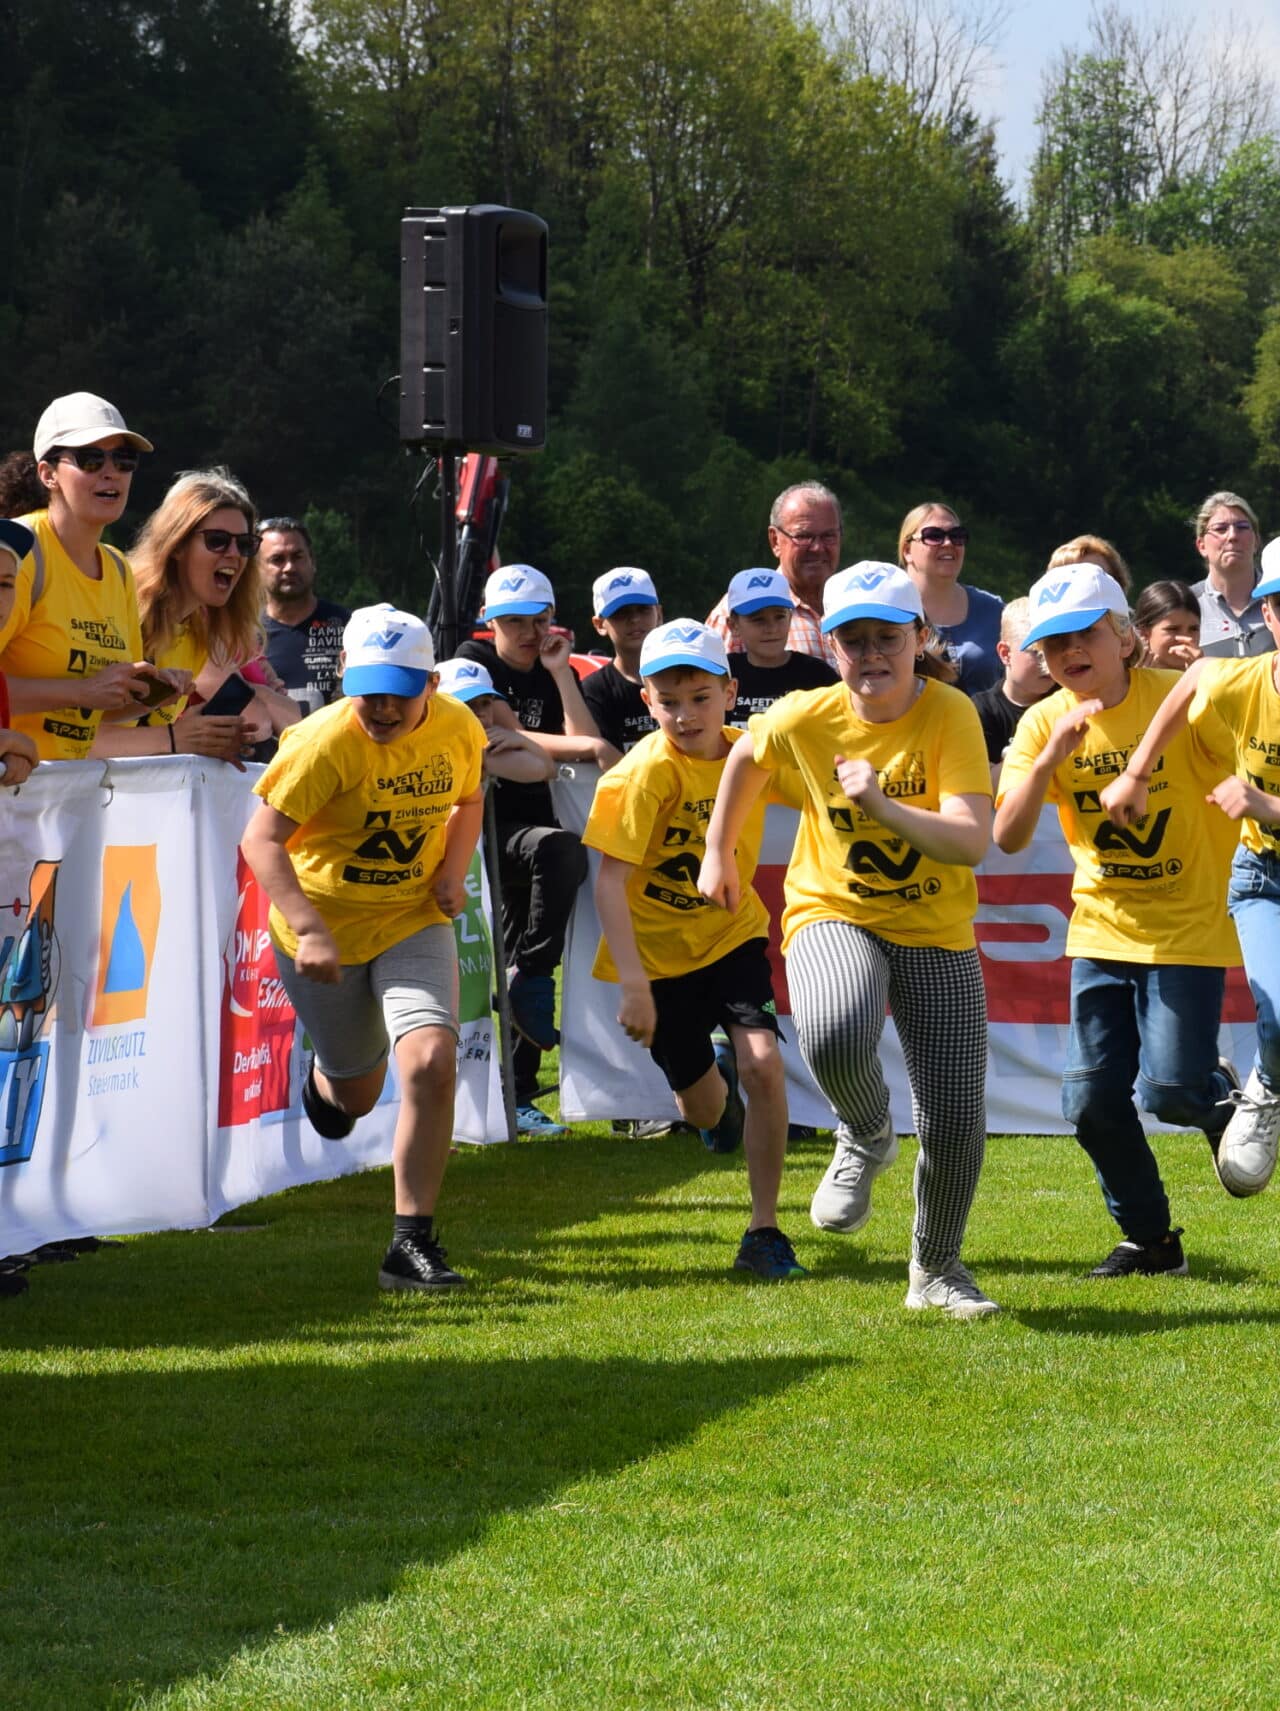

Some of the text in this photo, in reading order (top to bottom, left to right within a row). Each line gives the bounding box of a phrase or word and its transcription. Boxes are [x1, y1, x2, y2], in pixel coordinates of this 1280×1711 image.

[71, 618, 108, 634] SAFETY
[1074, 750, 1129, 769] SAFETY
[377, 771, 423, 789] SAFETY
[412, 780, 452, 797] tour
[1104, 866, 1161, 878] SPAR
[87, 1031, 147, 1065] ZIVILSCHUTZ
[87, 1068, 140, 1097] Steiermark
